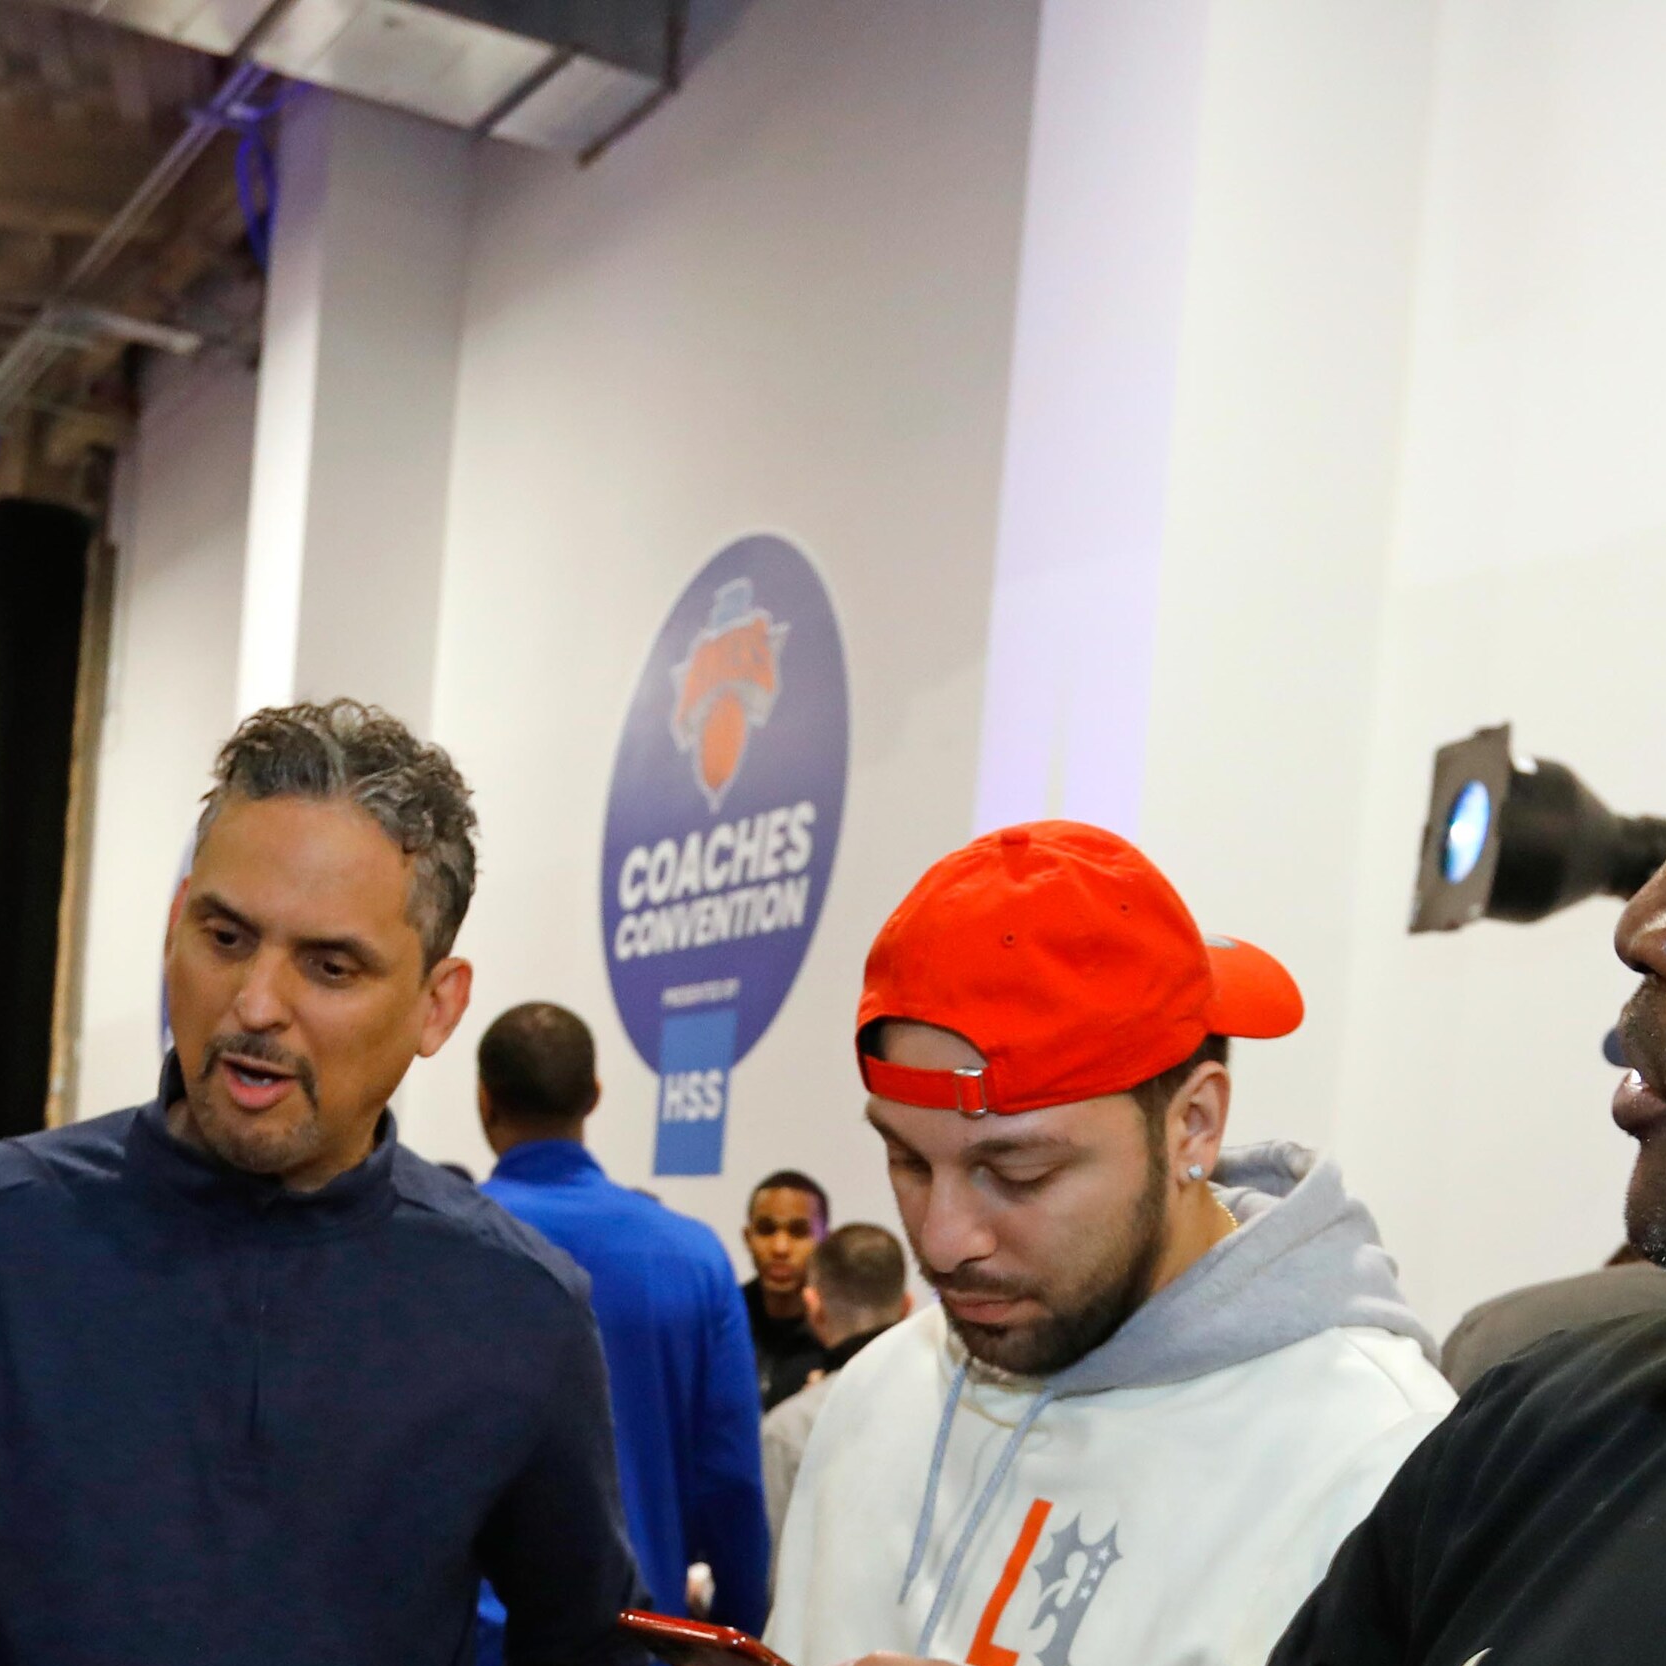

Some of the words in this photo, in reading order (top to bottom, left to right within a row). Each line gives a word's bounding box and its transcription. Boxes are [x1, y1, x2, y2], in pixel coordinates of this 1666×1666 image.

[617, 800, 817, 911] COACHES
[613, 875, 811, 962] CONVENTION
[662, 1067, 723, 1123] HSS
